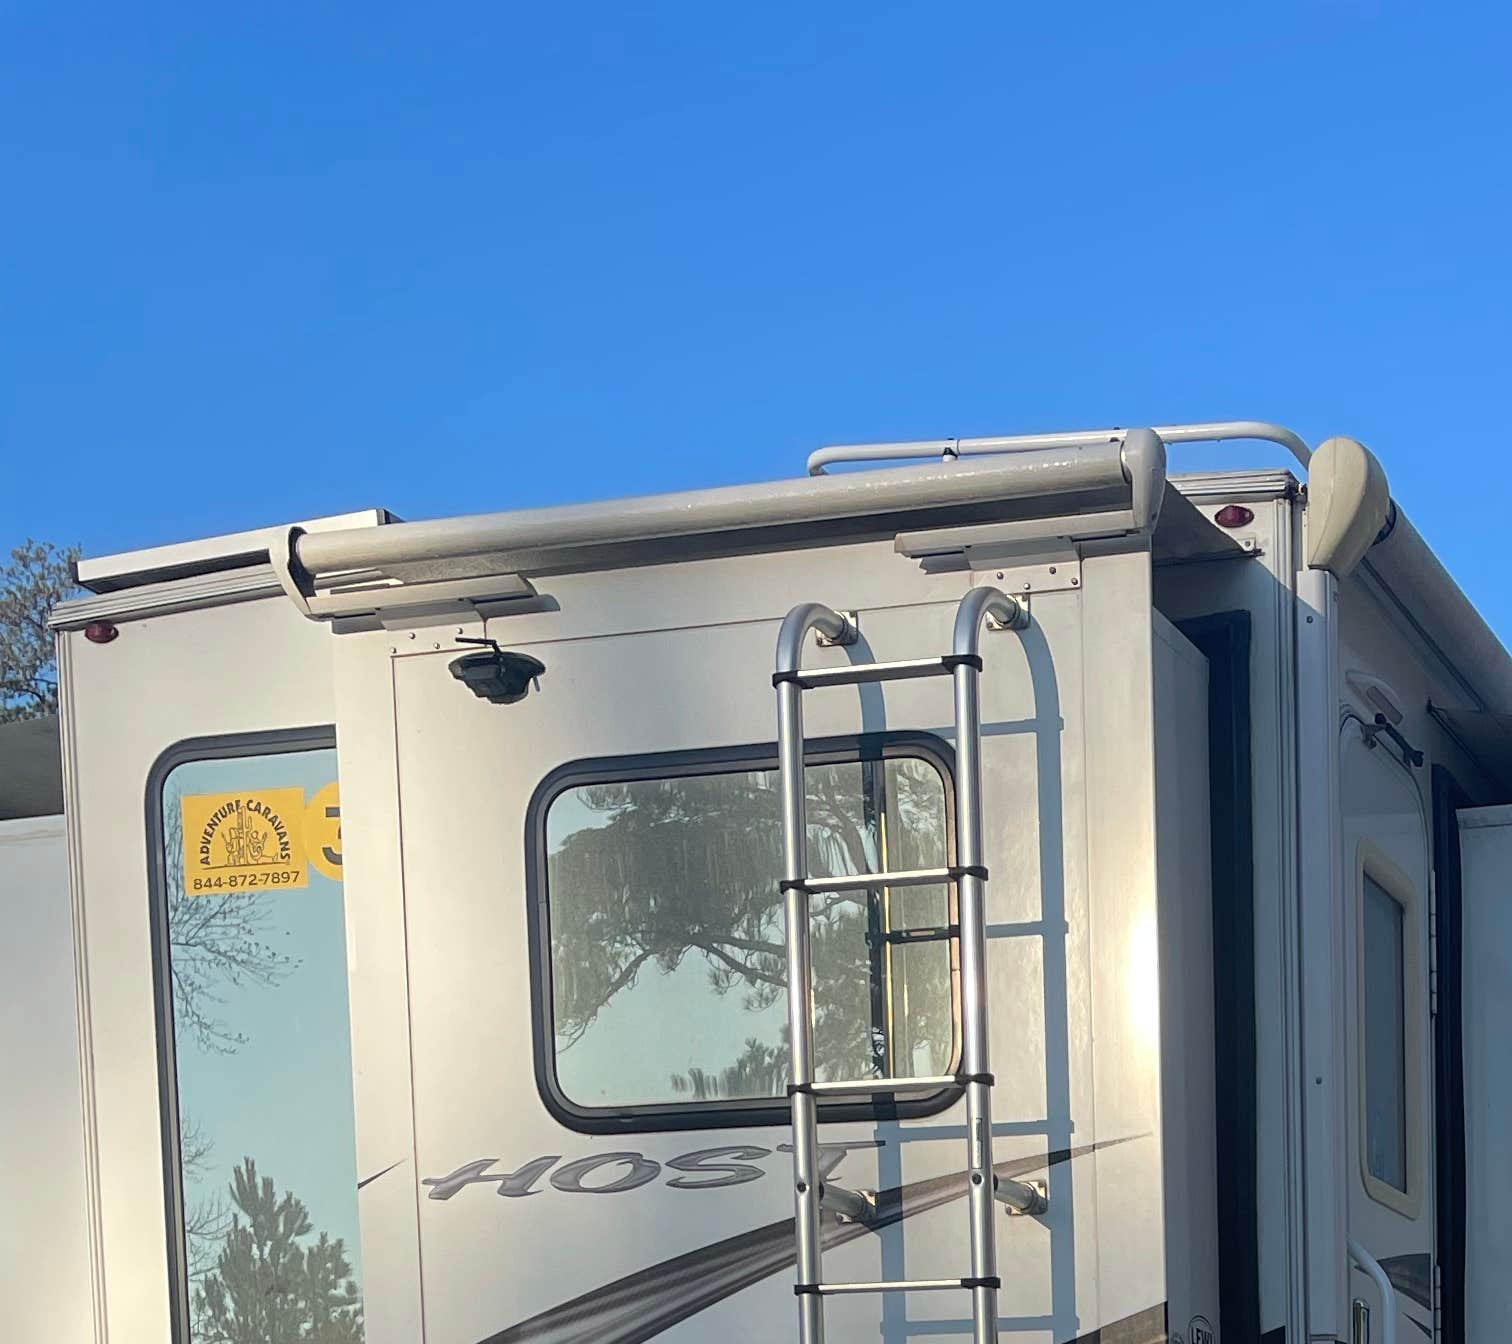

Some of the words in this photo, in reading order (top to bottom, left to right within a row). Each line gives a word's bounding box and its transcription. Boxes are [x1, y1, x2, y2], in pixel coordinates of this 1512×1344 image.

[200, 800, 241, 866] ADVENTURE
[246, 799, 291, 861] CARAVANS
[193, 870, 300, 890] 844-872-7897
